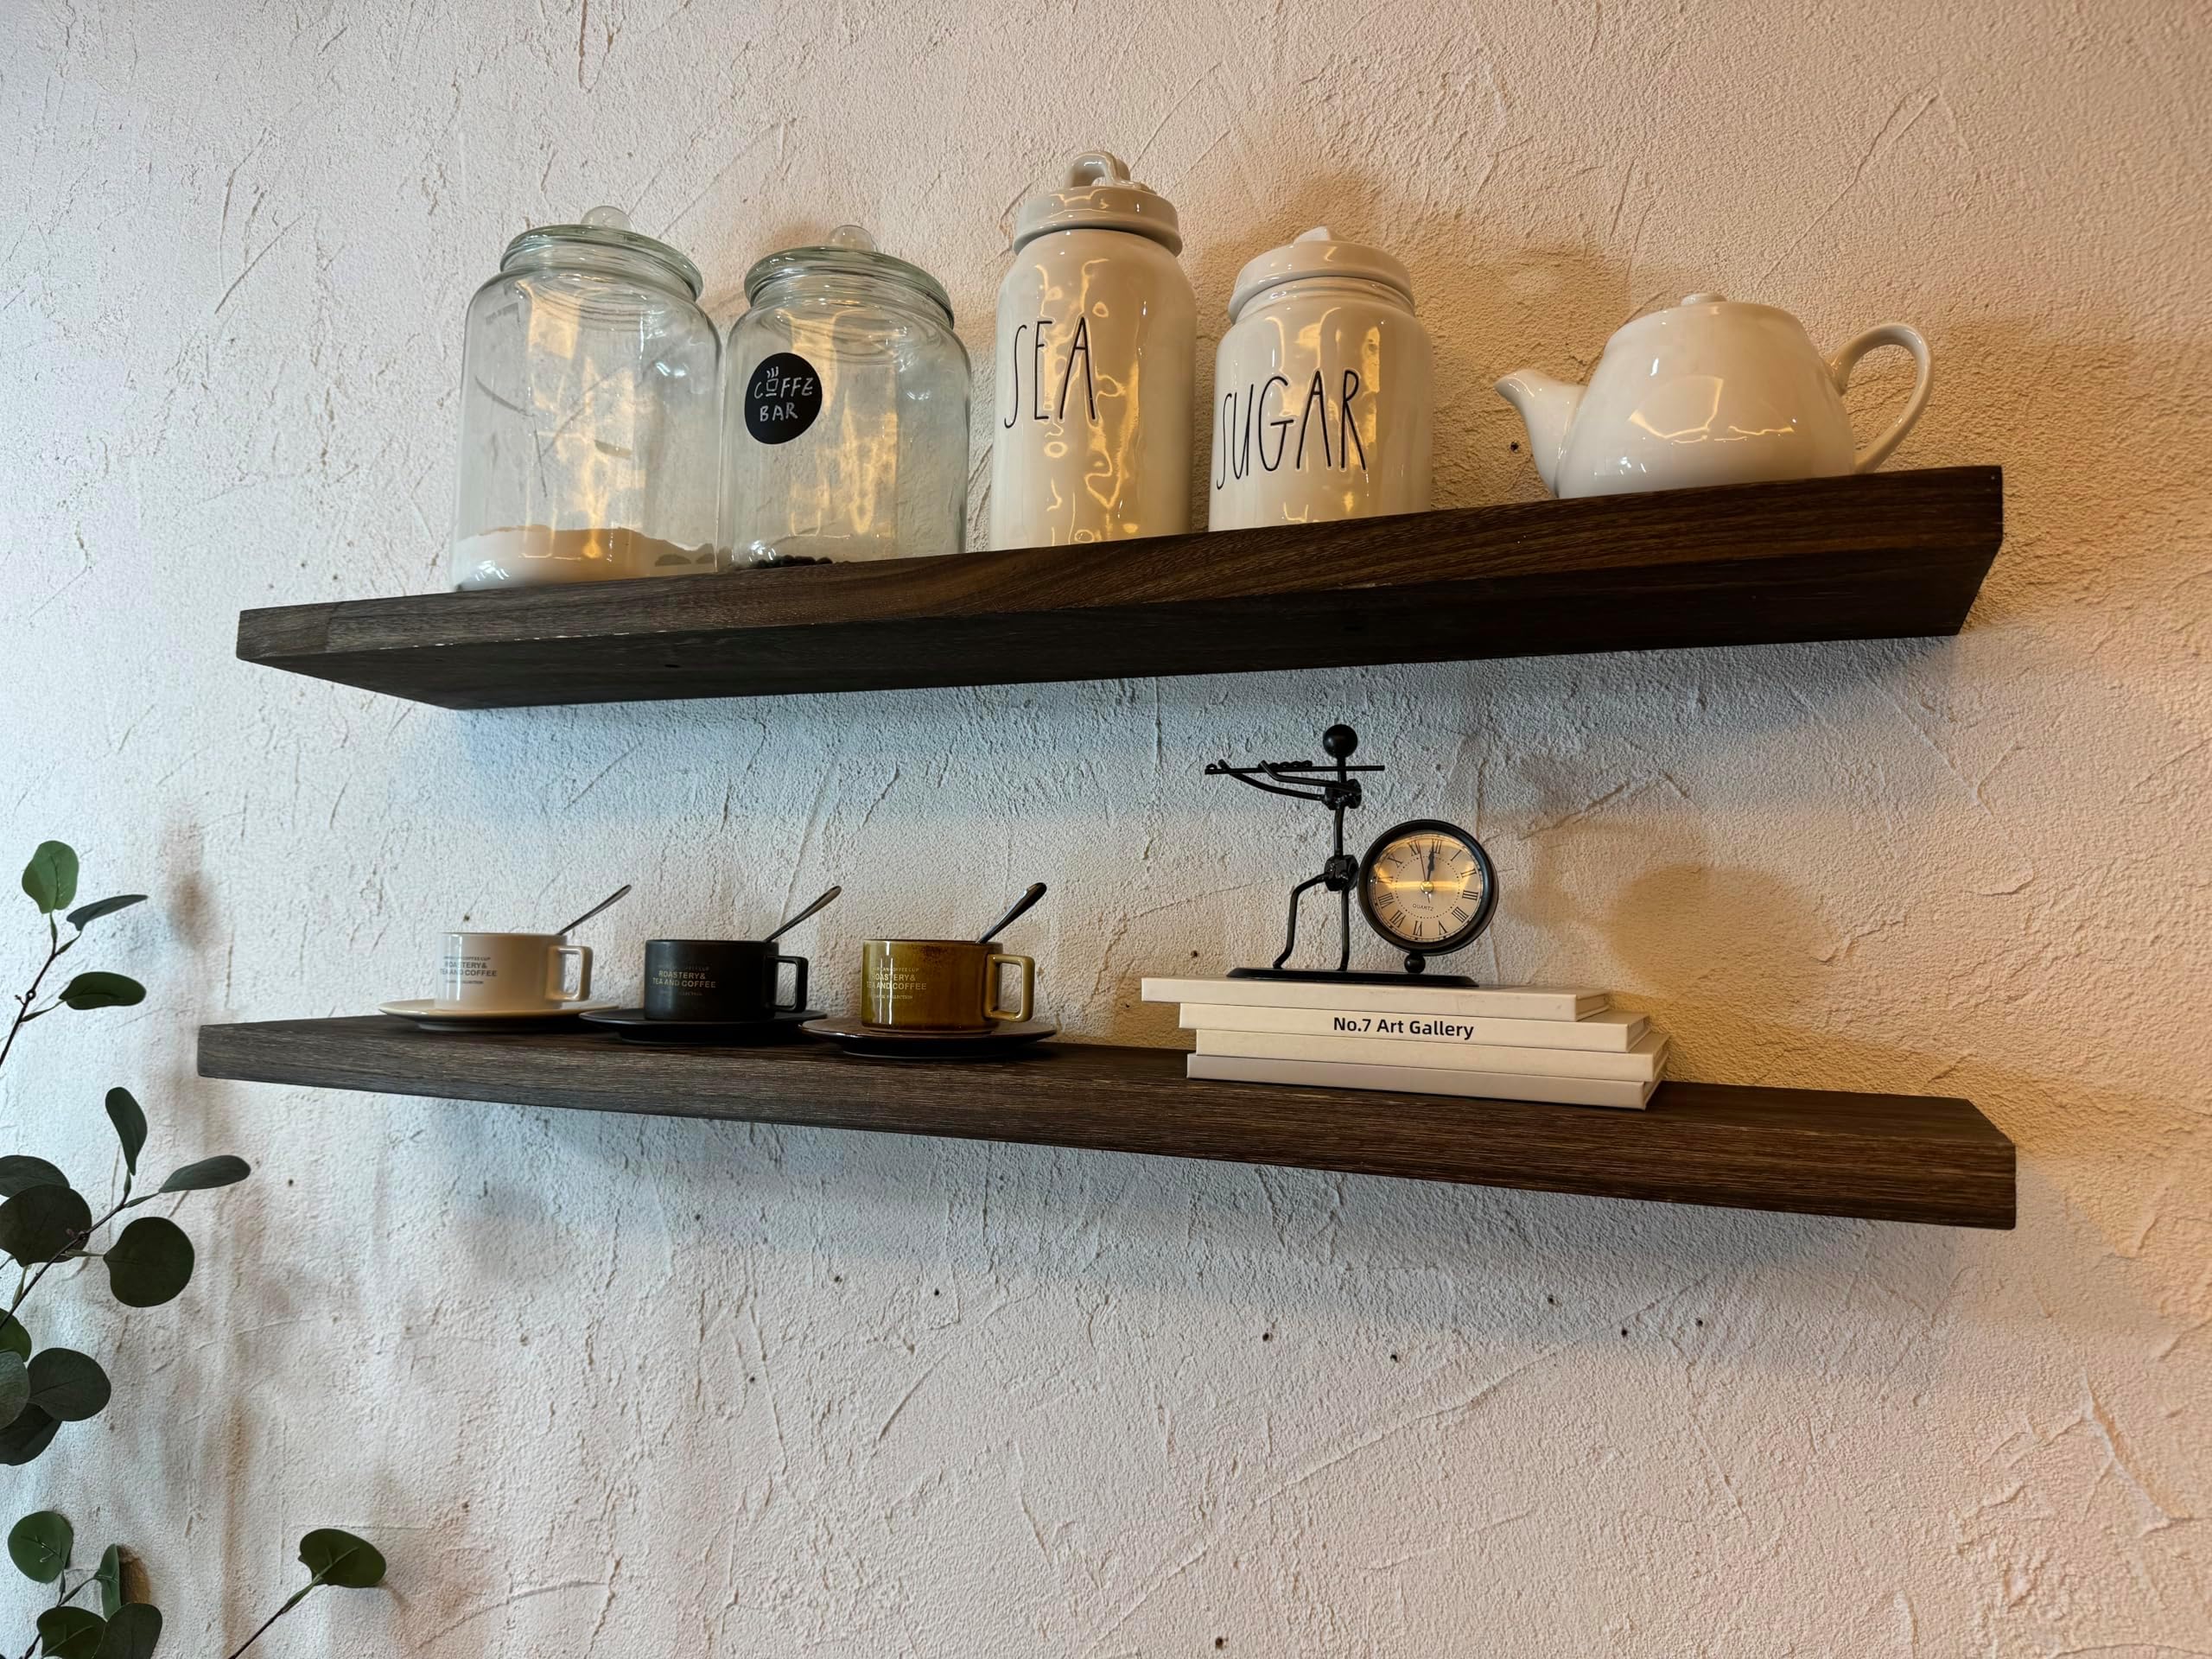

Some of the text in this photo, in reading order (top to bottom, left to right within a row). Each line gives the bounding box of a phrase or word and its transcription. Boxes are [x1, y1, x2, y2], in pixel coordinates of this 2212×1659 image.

[1004, 316, 1096, 429] SEA
[760, 402, 798, 422] BAR
[1216, 370, 1368, 490] SUGAR
[1412, 903, 1434, 912] QUARTZ
[681, 980, 716, 988] COFFEE
[1333, 1017, 1474, 1040] No.7 Art Gallery
